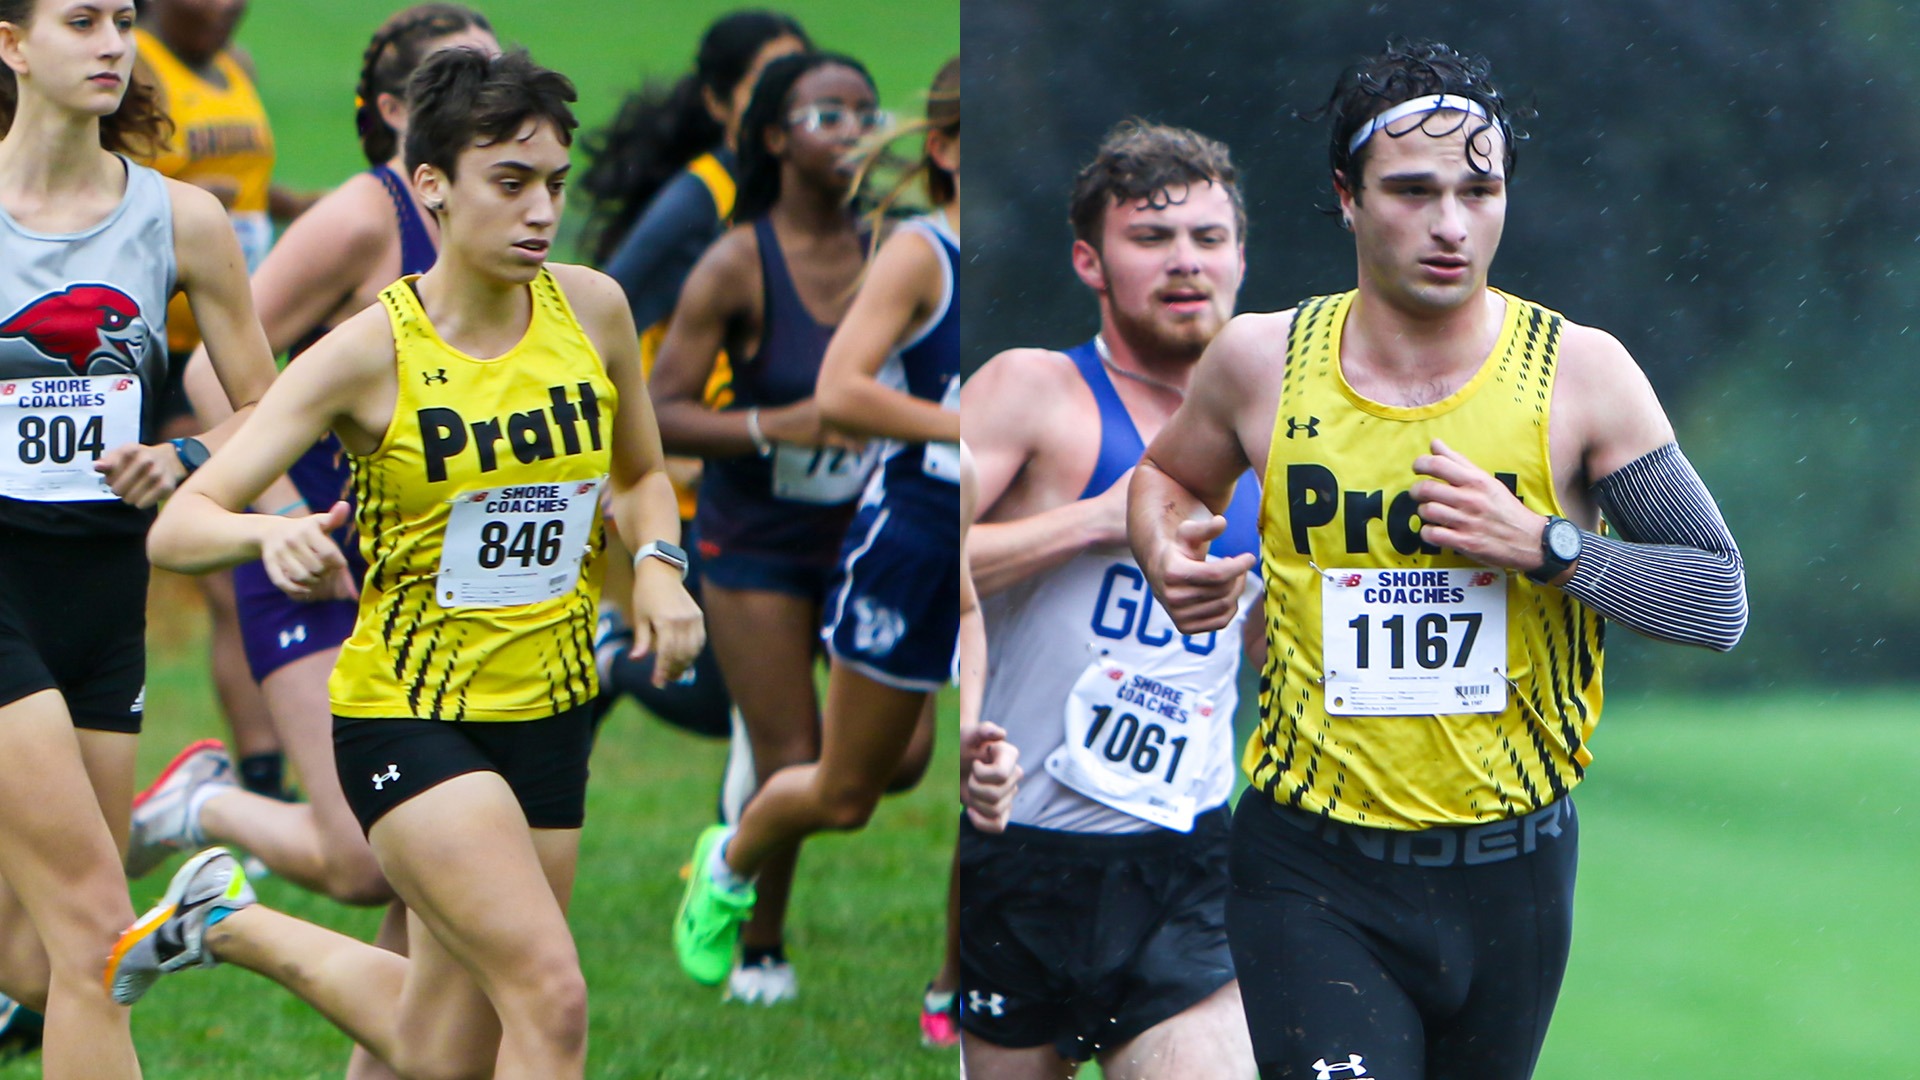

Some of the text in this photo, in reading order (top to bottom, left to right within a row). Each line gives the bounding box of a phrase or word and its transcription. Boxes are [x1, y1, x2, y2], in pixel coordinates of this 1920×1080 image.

[19, 393, 105, 408] COACHES
[32, 379, 91, 393] SHORE
[18, 415, 104, 464] 804
[417, 382, 602, 483] Pratt
[485, 498, 569, 514] COACHES
[501, 485, 559, 500] SHORE
[1286, 464, 1524, 556] Pra
[478, 519, 564, 569] 846
[1364, 587, 1465, 604] COACHES
[1378, 571, 1449, 587] SHORE
[1091, 563, 1216, 656] GC
[1348, 613, 1483, 670] 1167
[1131, 674, 1183, 706] SHORE
[1084, 704, 1188, 784] 1061
